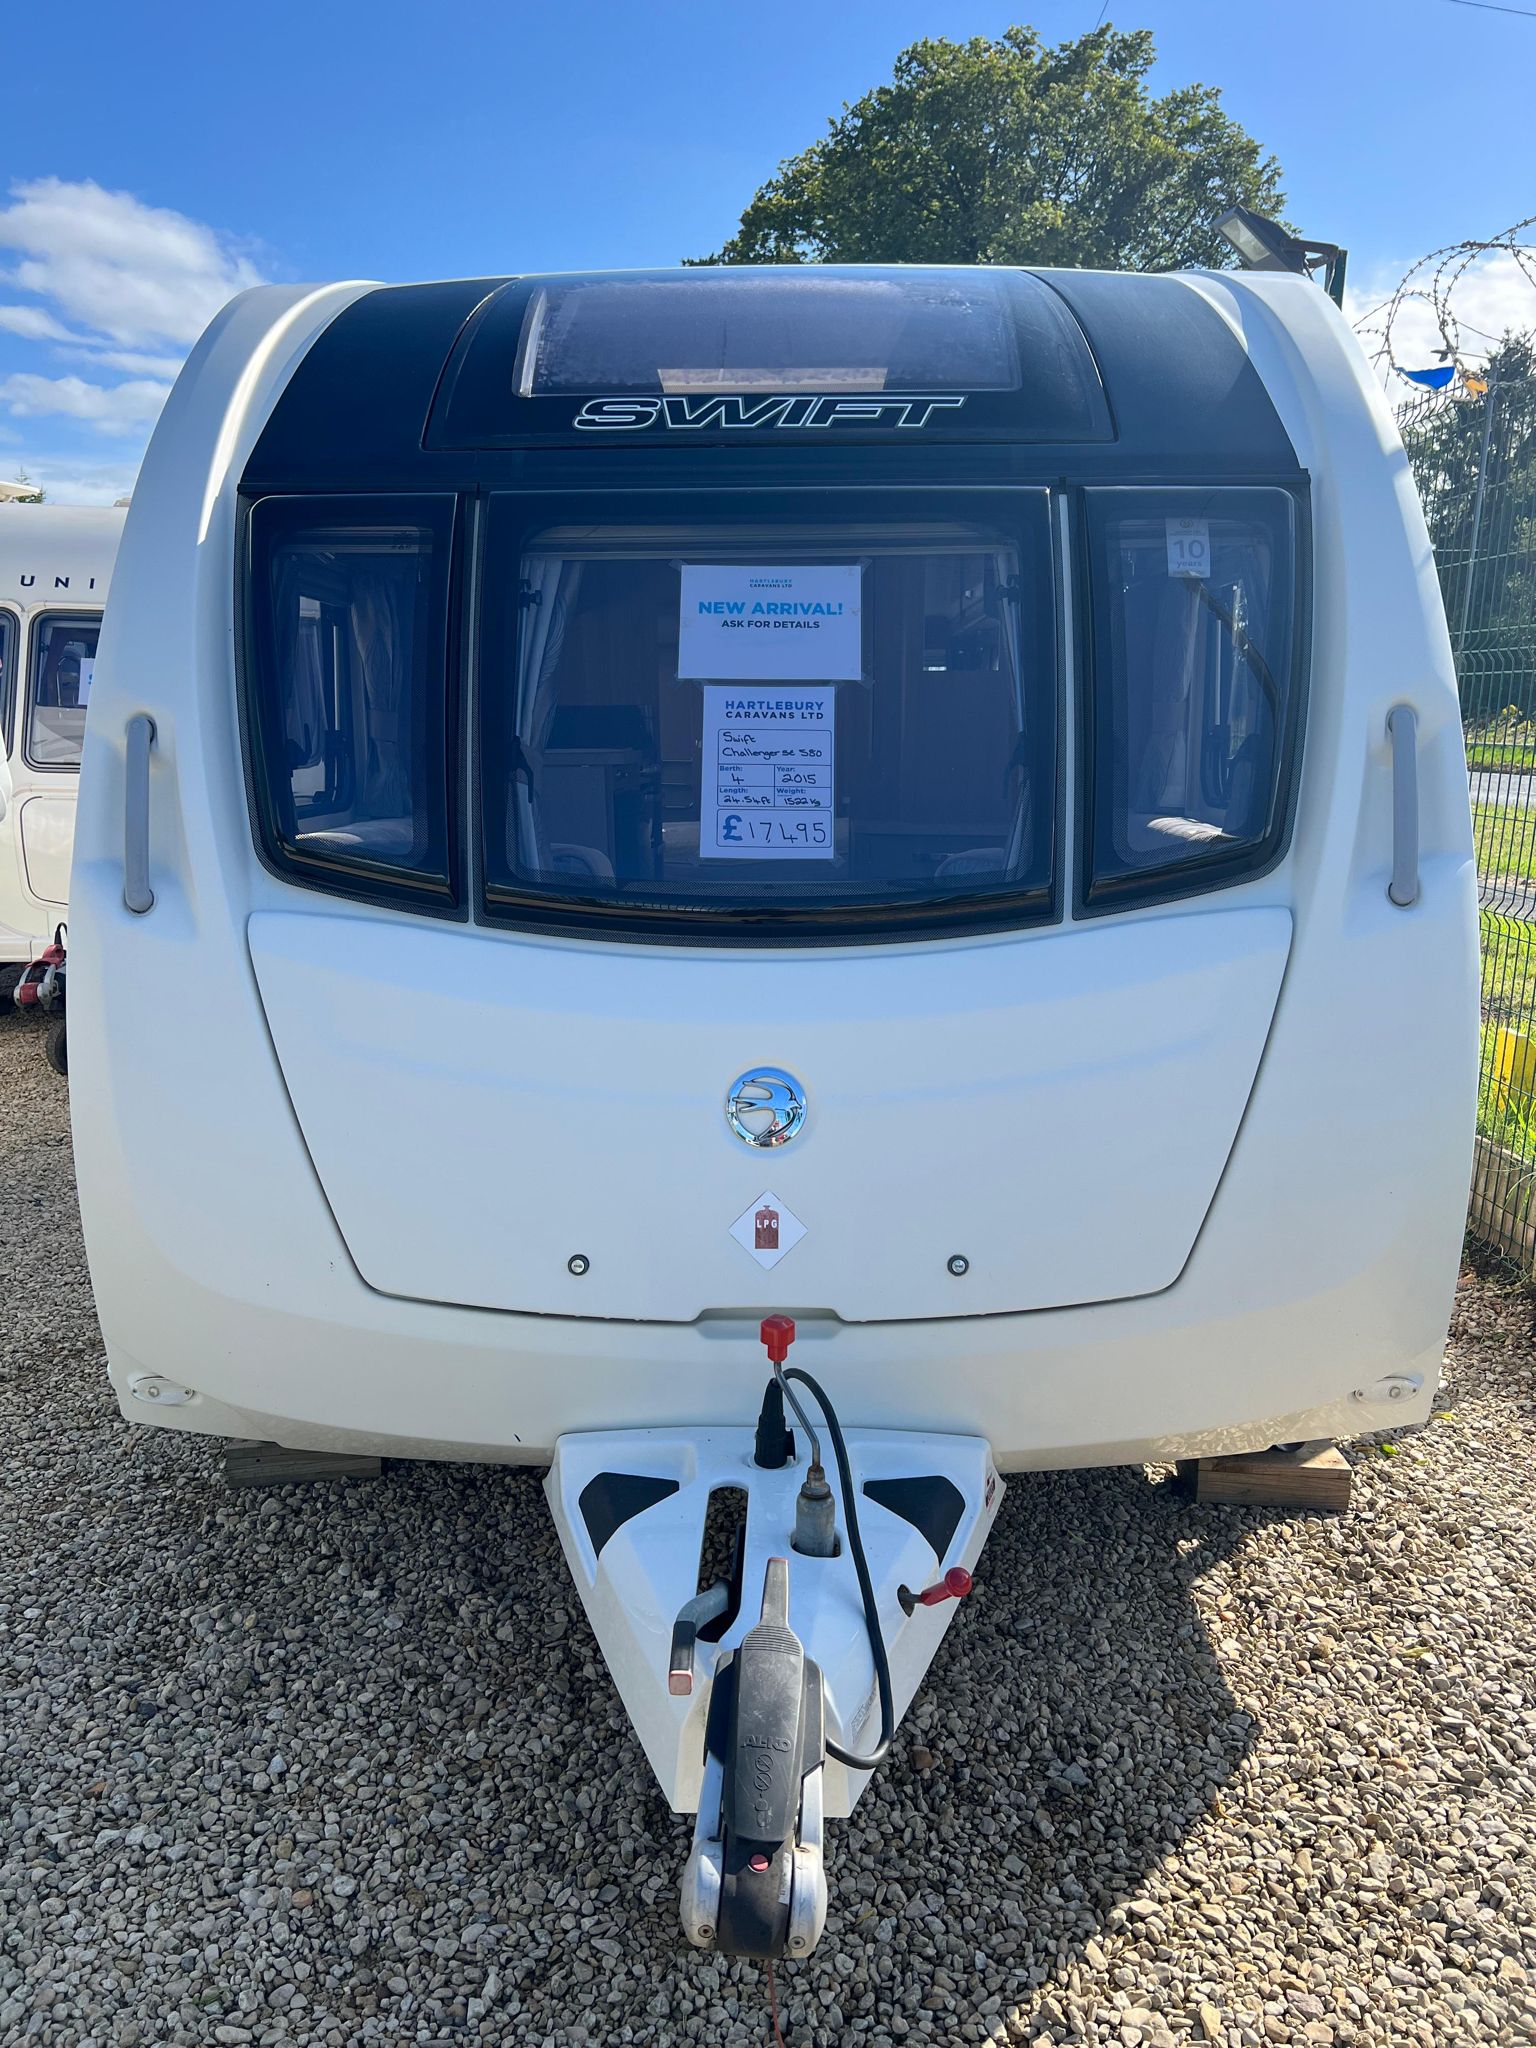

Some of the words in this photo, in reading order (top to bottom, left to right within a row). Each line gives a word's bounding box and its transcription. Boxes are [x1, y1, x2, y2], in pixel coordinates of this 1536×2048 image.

[573, 395, 968, 431] SWIFT
[1172, 539, 1205, 560] 10
[698, 601, 746, 615] NEW
[751, 602, 843, 616] ARRIVAL!
[721, 619, 745, 629] ASK
[747, 620, 770, 629] FOR
[773, 620, 821, 630] DETAILS
[725, 700, 825, 711] HARTLEBURY
[725, 711, 795, 720] CARAVANS
[801, 712, 825, 720] LTD
[722, 731, 757, 745] Swift
[722, 747, 780, 761] Challenger
[731, 773, 745, 785] 4
[781, 773, 817, 785] 2015
[756, 1219, 778, 1229] LPG
